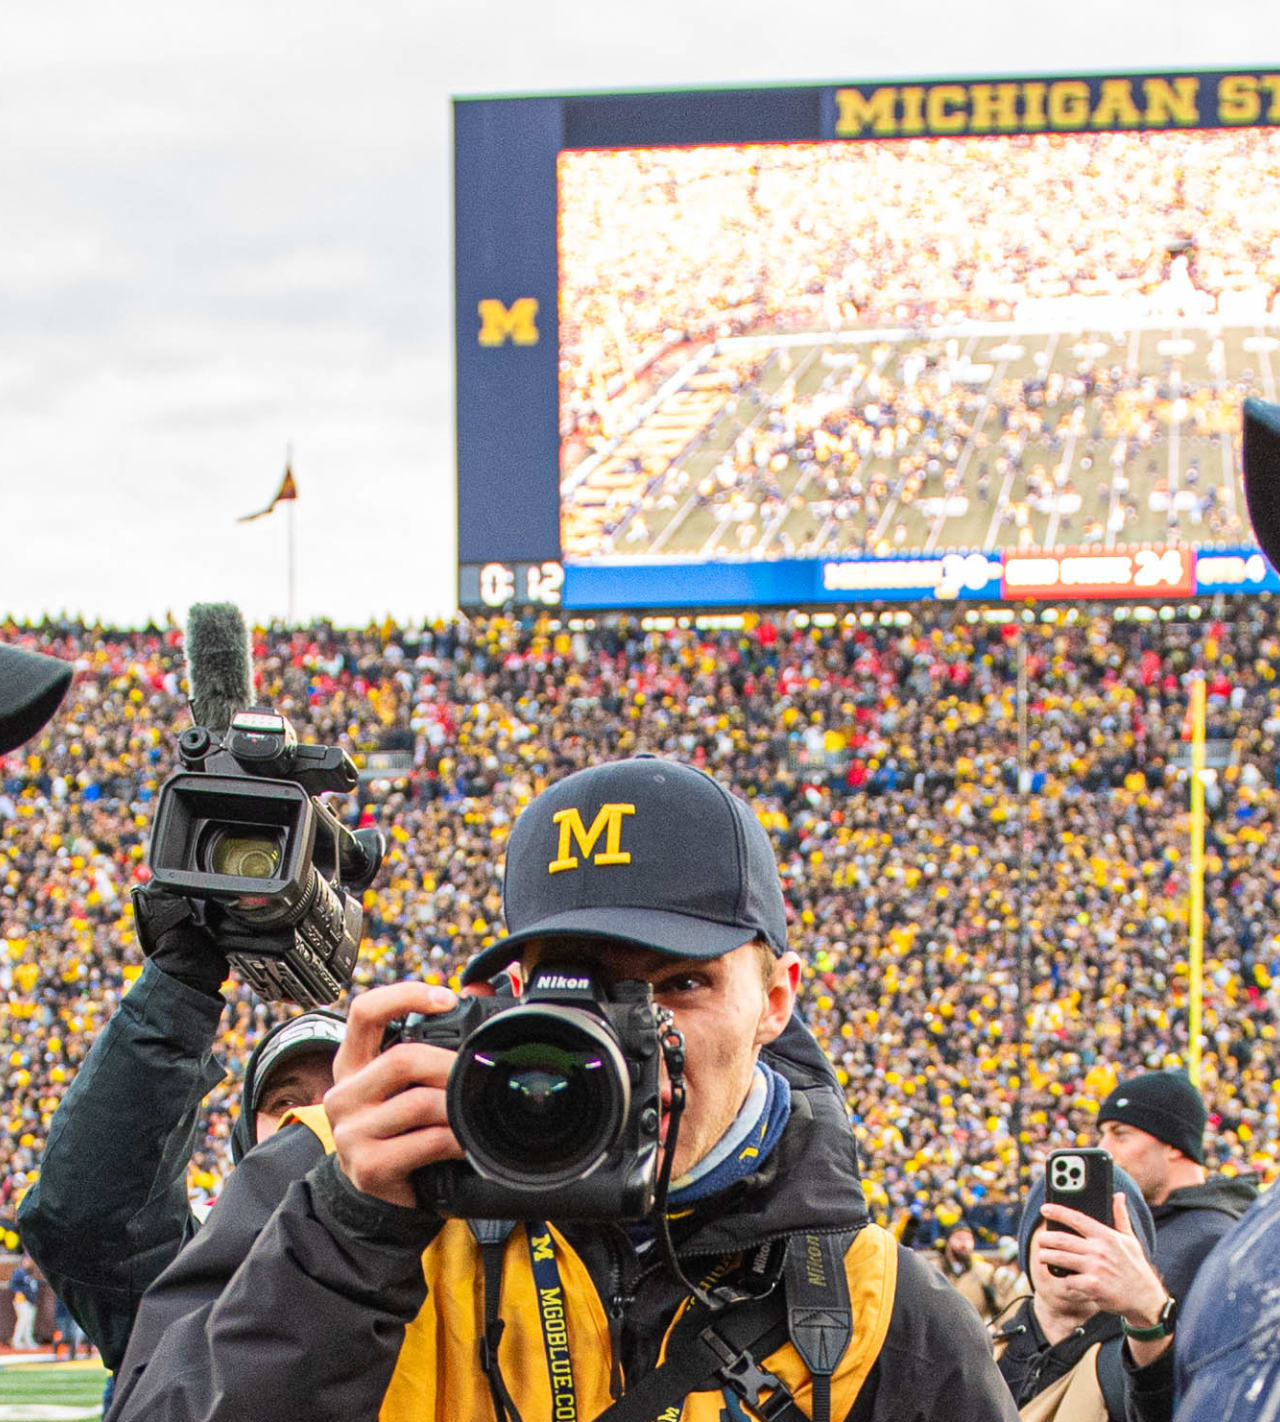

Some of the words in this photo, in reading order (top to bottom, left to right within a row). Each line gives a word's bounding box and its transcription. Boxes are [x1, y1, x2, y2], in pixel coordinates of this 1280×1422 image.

[834, 75, 1199, 137] MICHIGAN
[477, 296, 539, 347] M
[480, 561, 565, 607] 0:12
[548, 802, 637, 875] M
[537, 976, 589, 989] Nikon
[531, 1233, 555, 1262] M
[806, 1234, 827, 1288] Nikon
